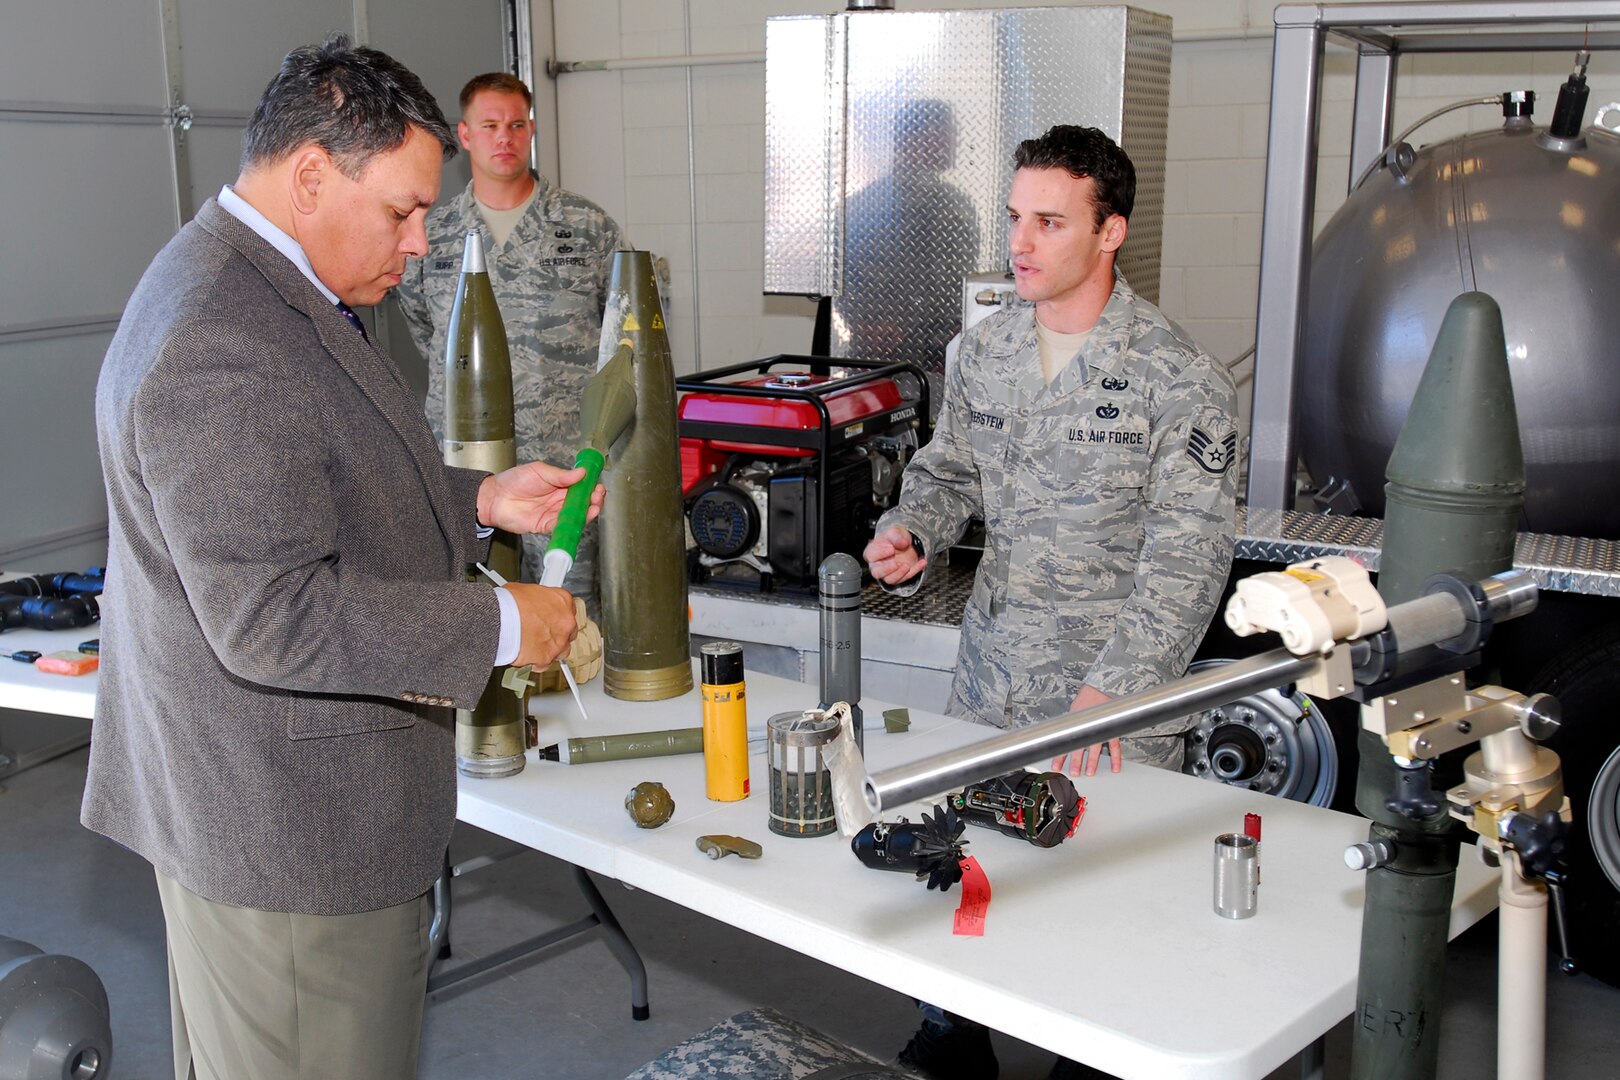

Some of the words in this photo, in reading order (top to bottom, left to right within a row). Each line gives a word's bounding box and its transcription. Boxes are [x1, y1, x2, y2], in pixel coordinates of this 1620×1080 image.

[890, 407, 916, 423] HONDA
[1068, 428, 1086, 442] U.S.
[1088, 429, 1106, 443] AIR
[1108, 431, 1144, 445] FORCE
